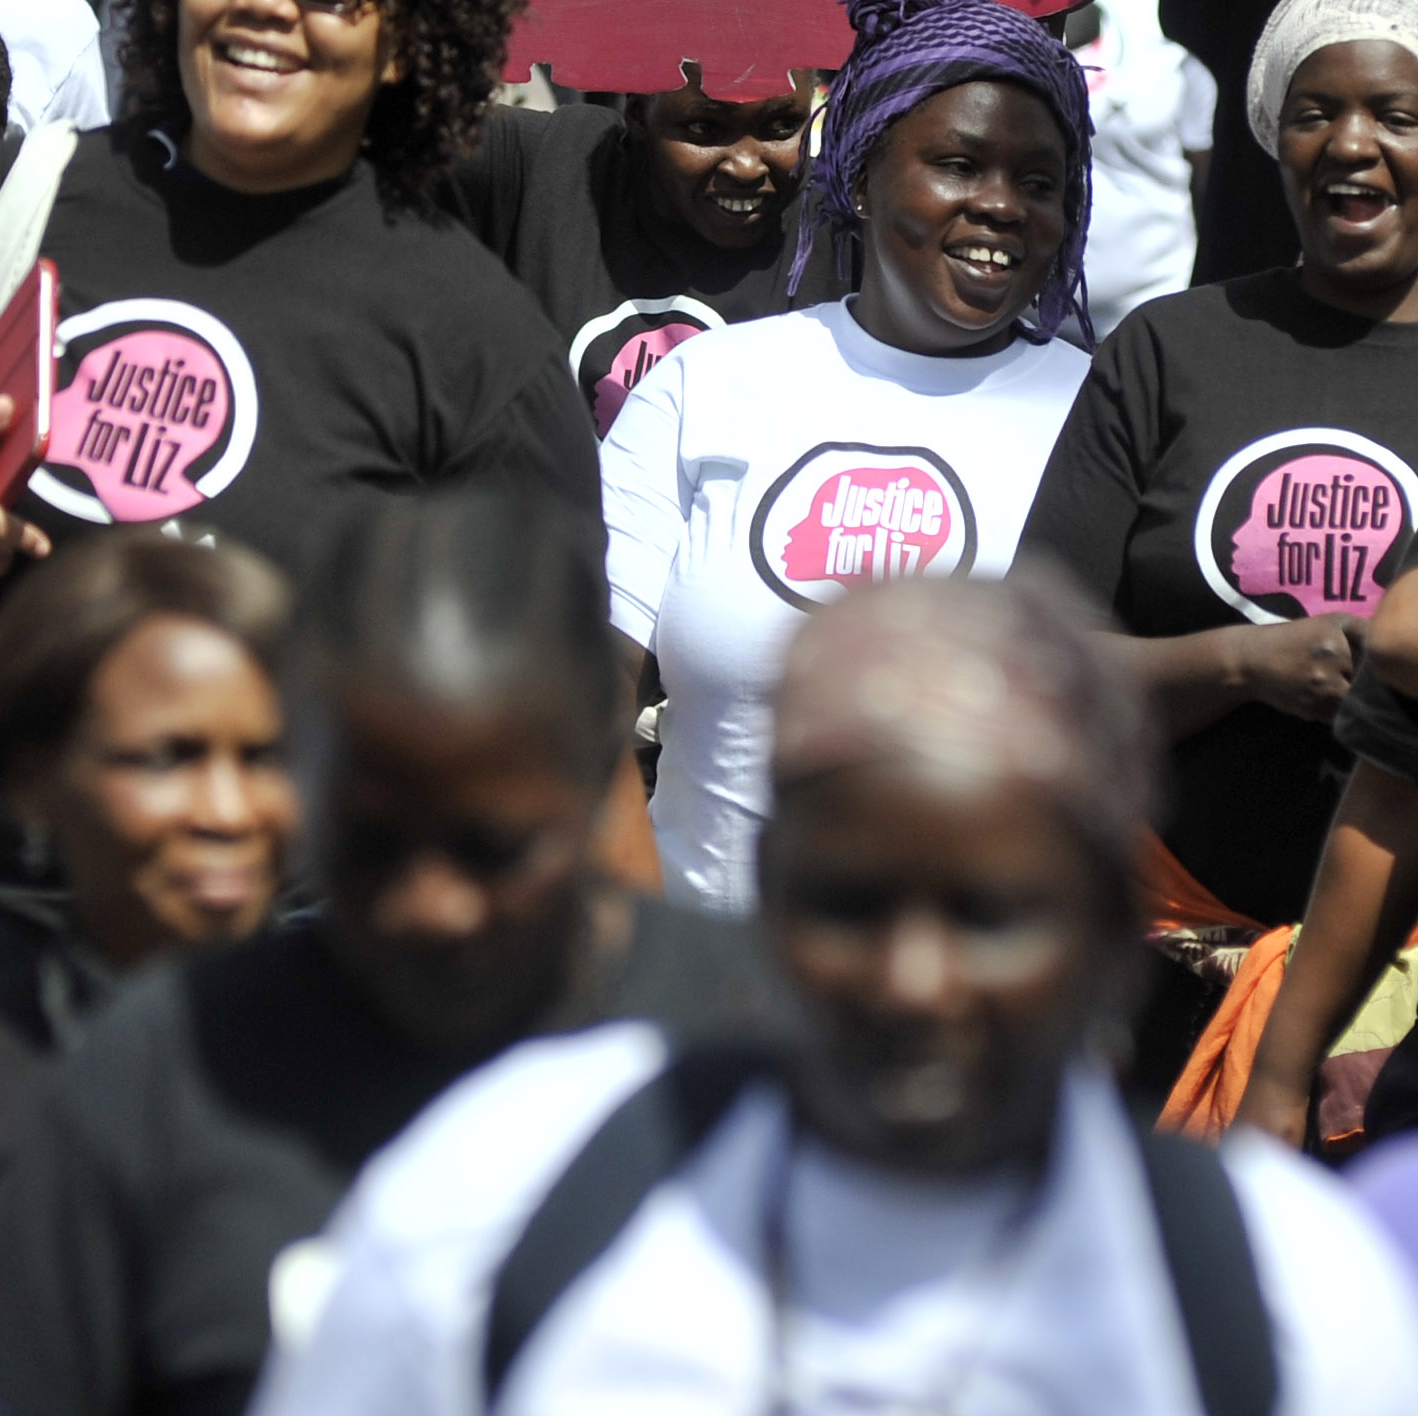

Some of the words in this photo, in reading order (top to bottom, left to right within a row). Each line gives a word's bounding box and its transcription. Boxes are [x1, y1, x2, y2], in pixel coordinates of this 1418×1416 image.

[88, 350, 218, 430] Justice
[77, 409, 131, 465] for
[122, 422, 181, 496] Liz
[821, 475, 944, 536] Justice
[1266, 472, 1391, 531] Justice
[825, 527, 863, 575] for
[1277, 531, 1321, 587] for
[1323, 532, 1369, 603] Liz
